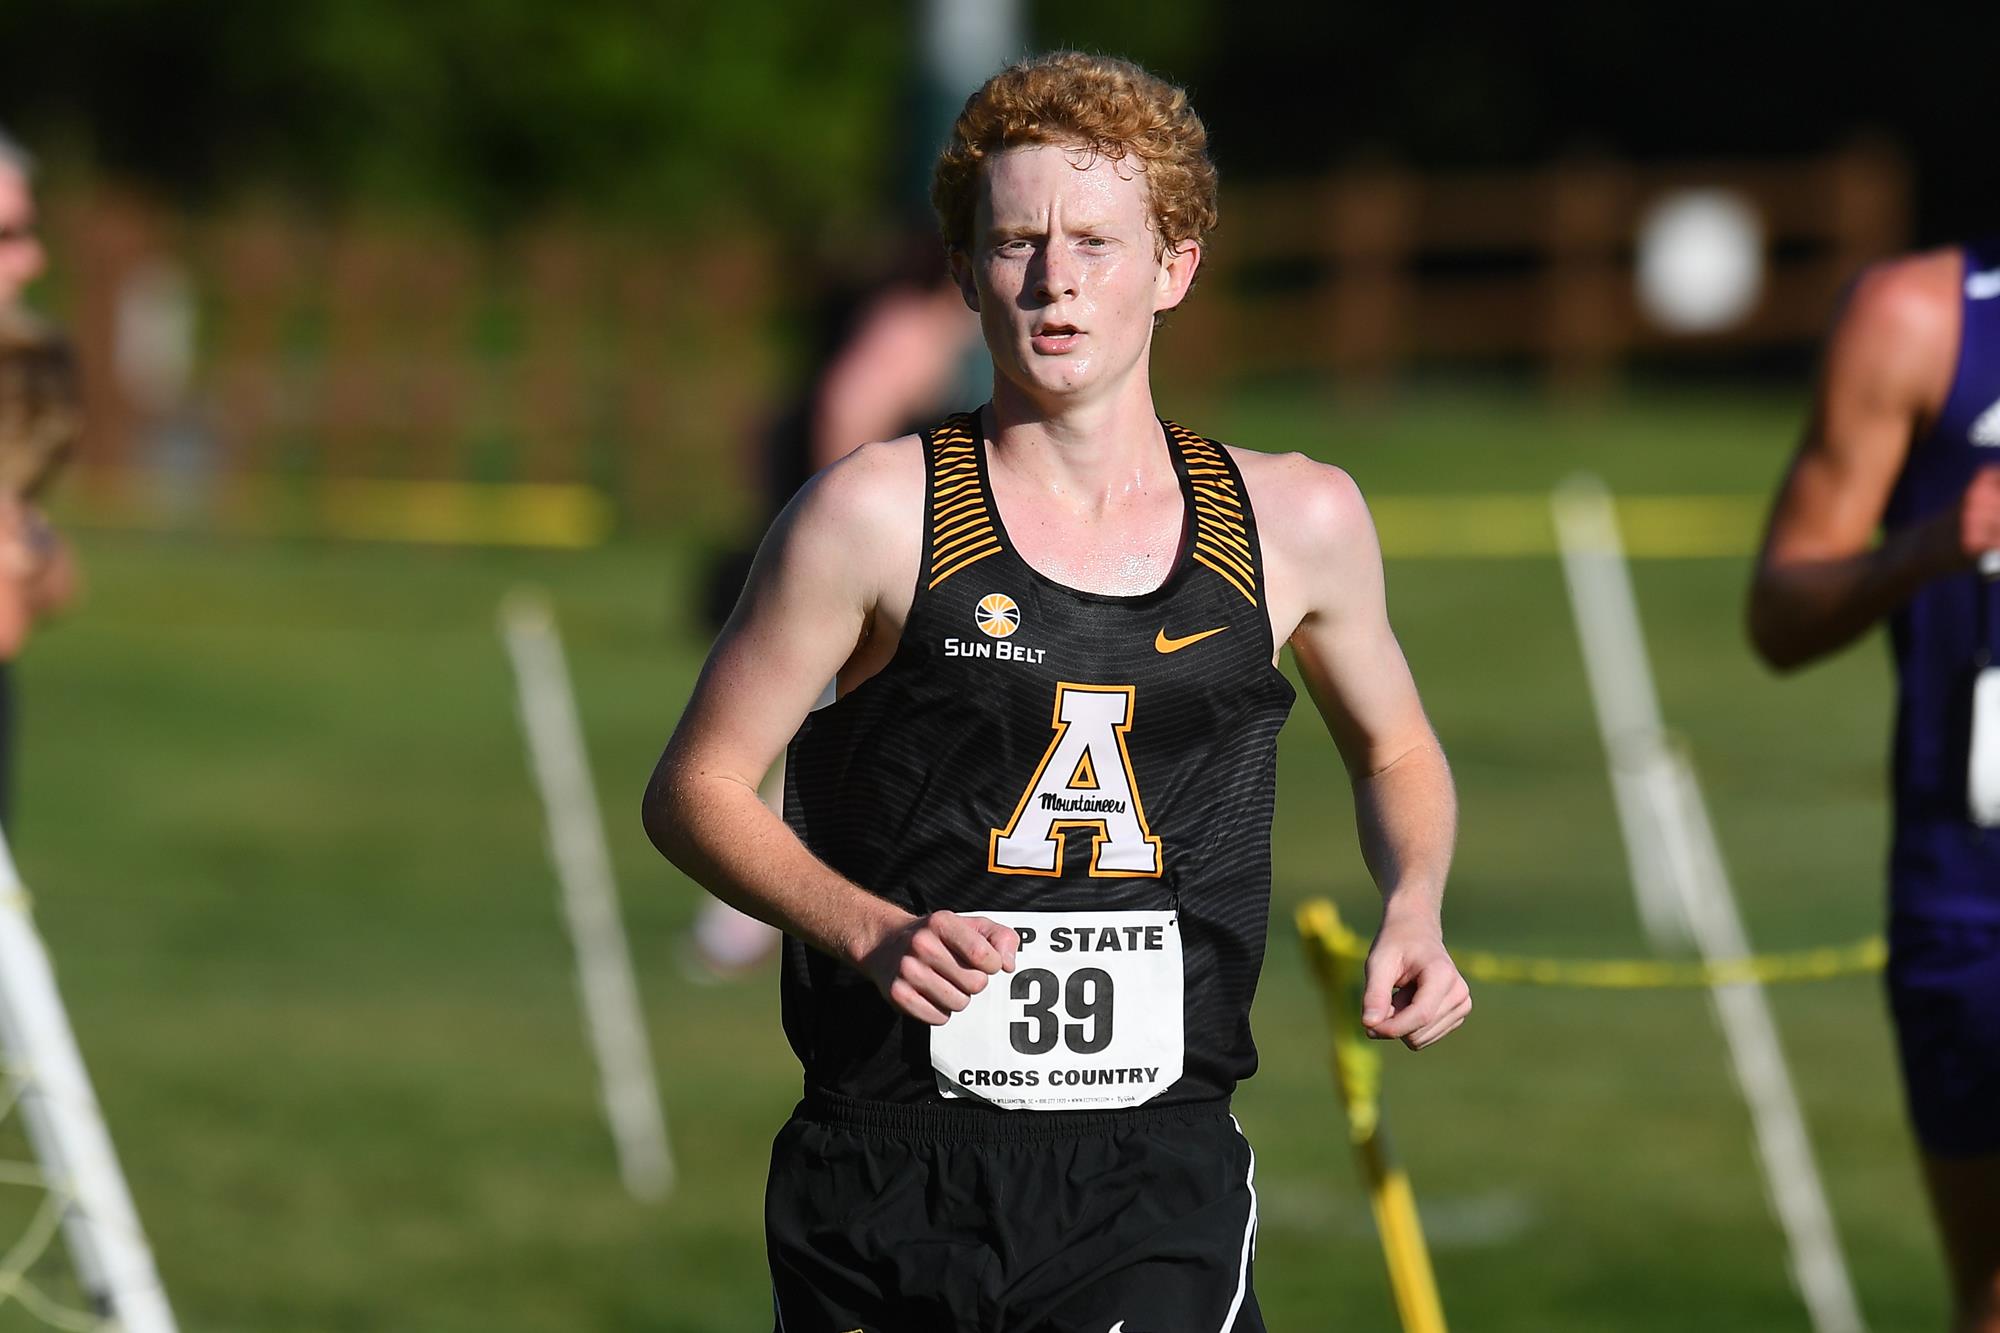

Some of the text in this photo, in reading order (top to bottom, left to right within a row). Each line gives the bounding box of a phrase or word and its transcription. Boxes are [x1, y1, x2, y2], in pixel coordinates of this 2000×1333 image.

[944, 637, 1046, 664] SUN BELT
[1037, 792, 1127, 814] Mountaineers
[1049, 925, 1164, 953] STATE
[1009, 967, 1114, 1056] 39
[958, 1066, 1160, 1087] CROSS COUNTRY
